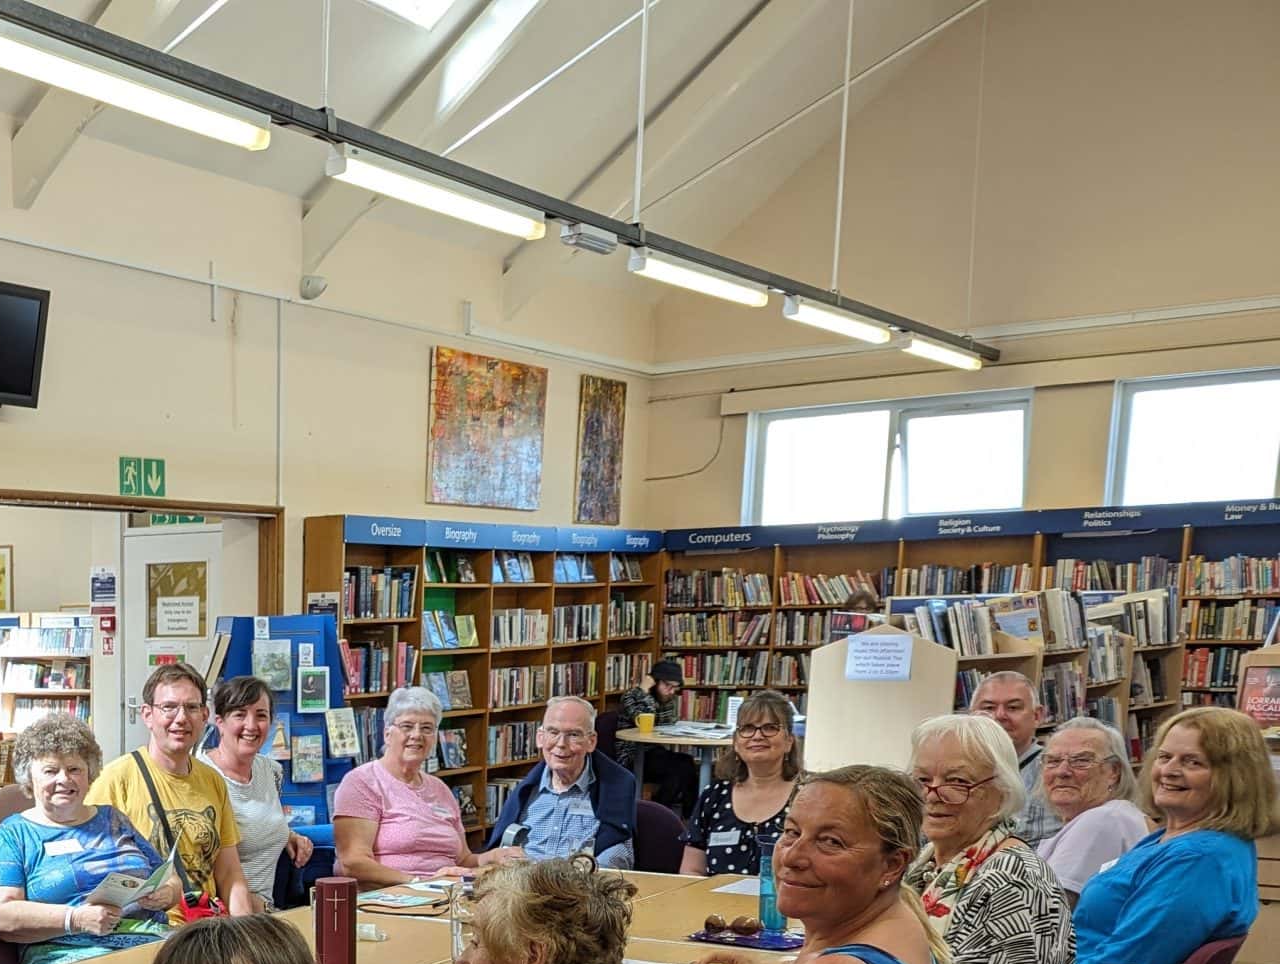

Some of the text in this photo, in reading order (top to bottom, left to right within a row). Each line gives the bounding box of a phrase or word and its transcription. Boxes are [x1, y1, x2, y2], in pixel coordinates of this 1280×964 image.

[1225, 504, 1258, 513] Money
[1083, 510, 1142, 520] Relationships
[1225, 513, 1244, 521] Law
[939, 519, 972, 528] Religion
[1083, 519, 1113, 528] Politics
[371, 523, 402, 538] Oversize
[445, 527, 478, 544] Biography
[938, 527, 965, 536] Society
[973, 525, 1002, 534] Culture
[512, 530, 541, 546] Biography
[572, 533, 598, 548] Biography
[626, 535, 650, 548] Biography
[689, 531, 753, 546] Computers
